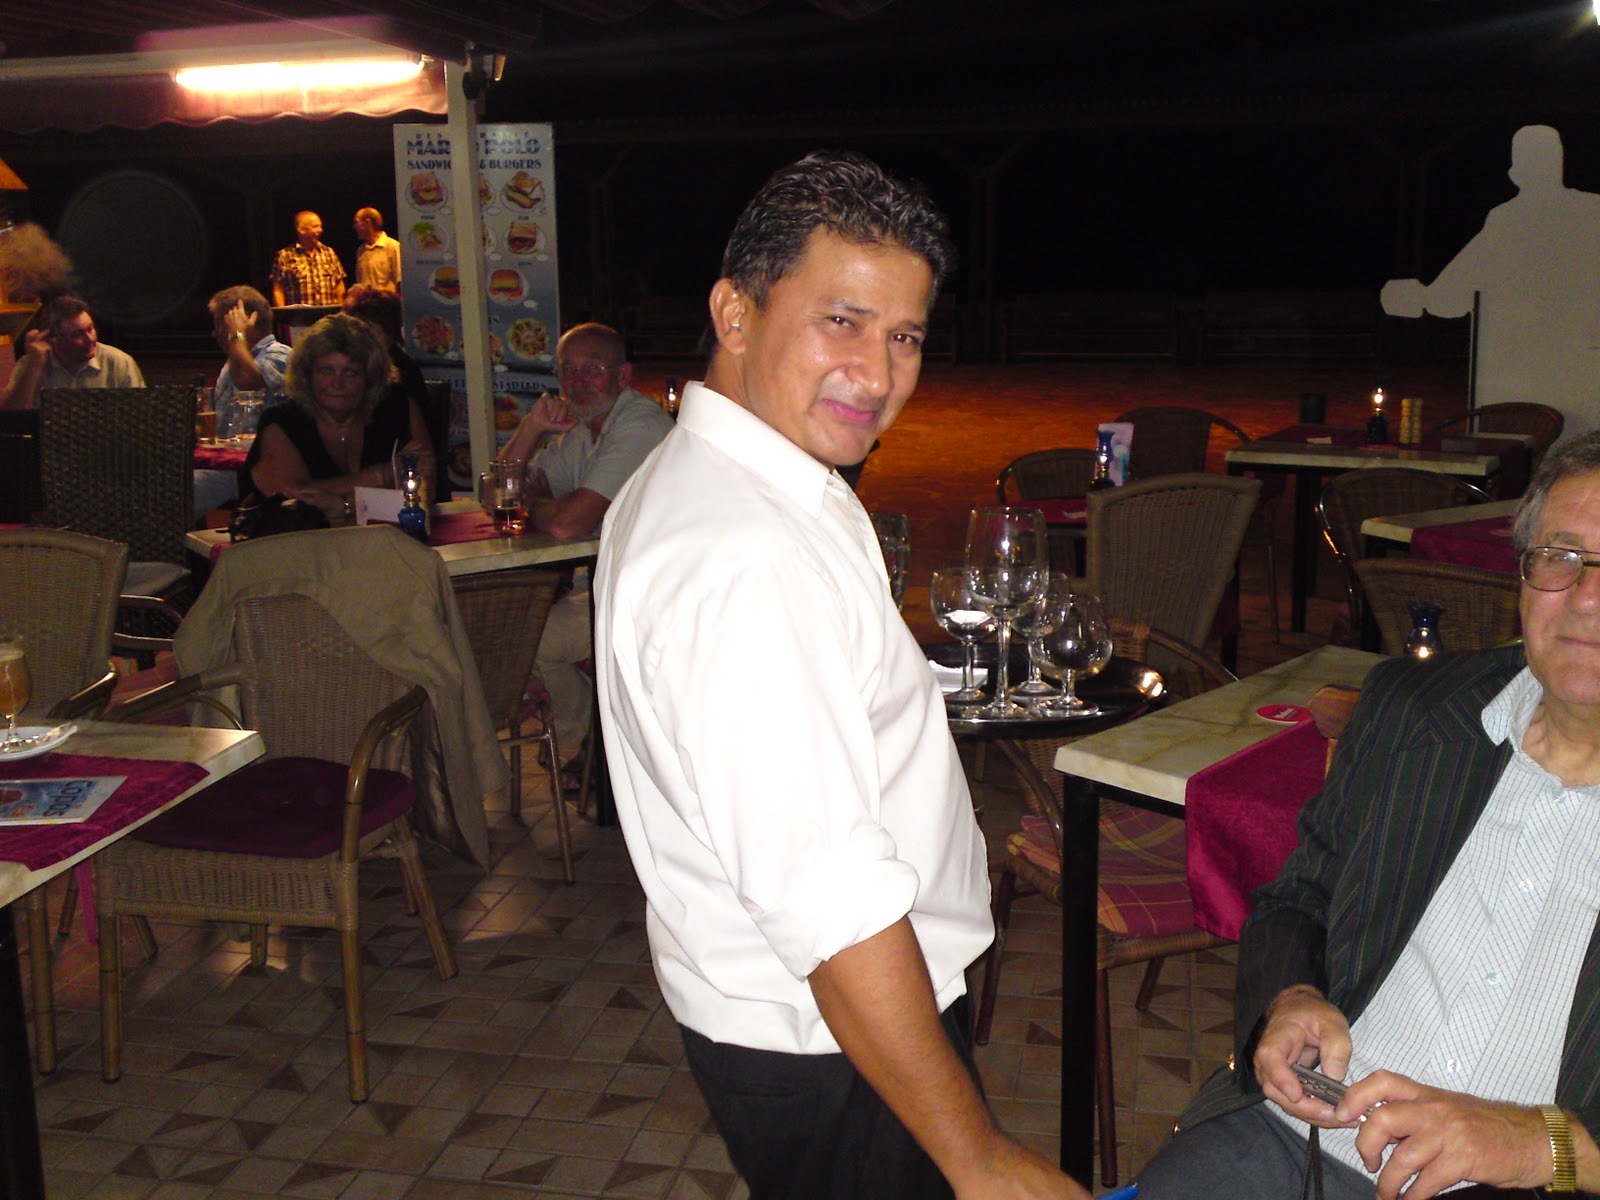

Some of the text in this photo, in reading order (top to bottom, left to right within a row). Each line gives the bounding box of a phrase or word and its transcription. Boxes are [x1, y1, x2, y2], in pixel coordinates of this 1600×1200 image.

[485, 139, 540, 155] POLO
[489, 159, 542, 170] BURGERS
[42, 780, 93, 816] Copas
